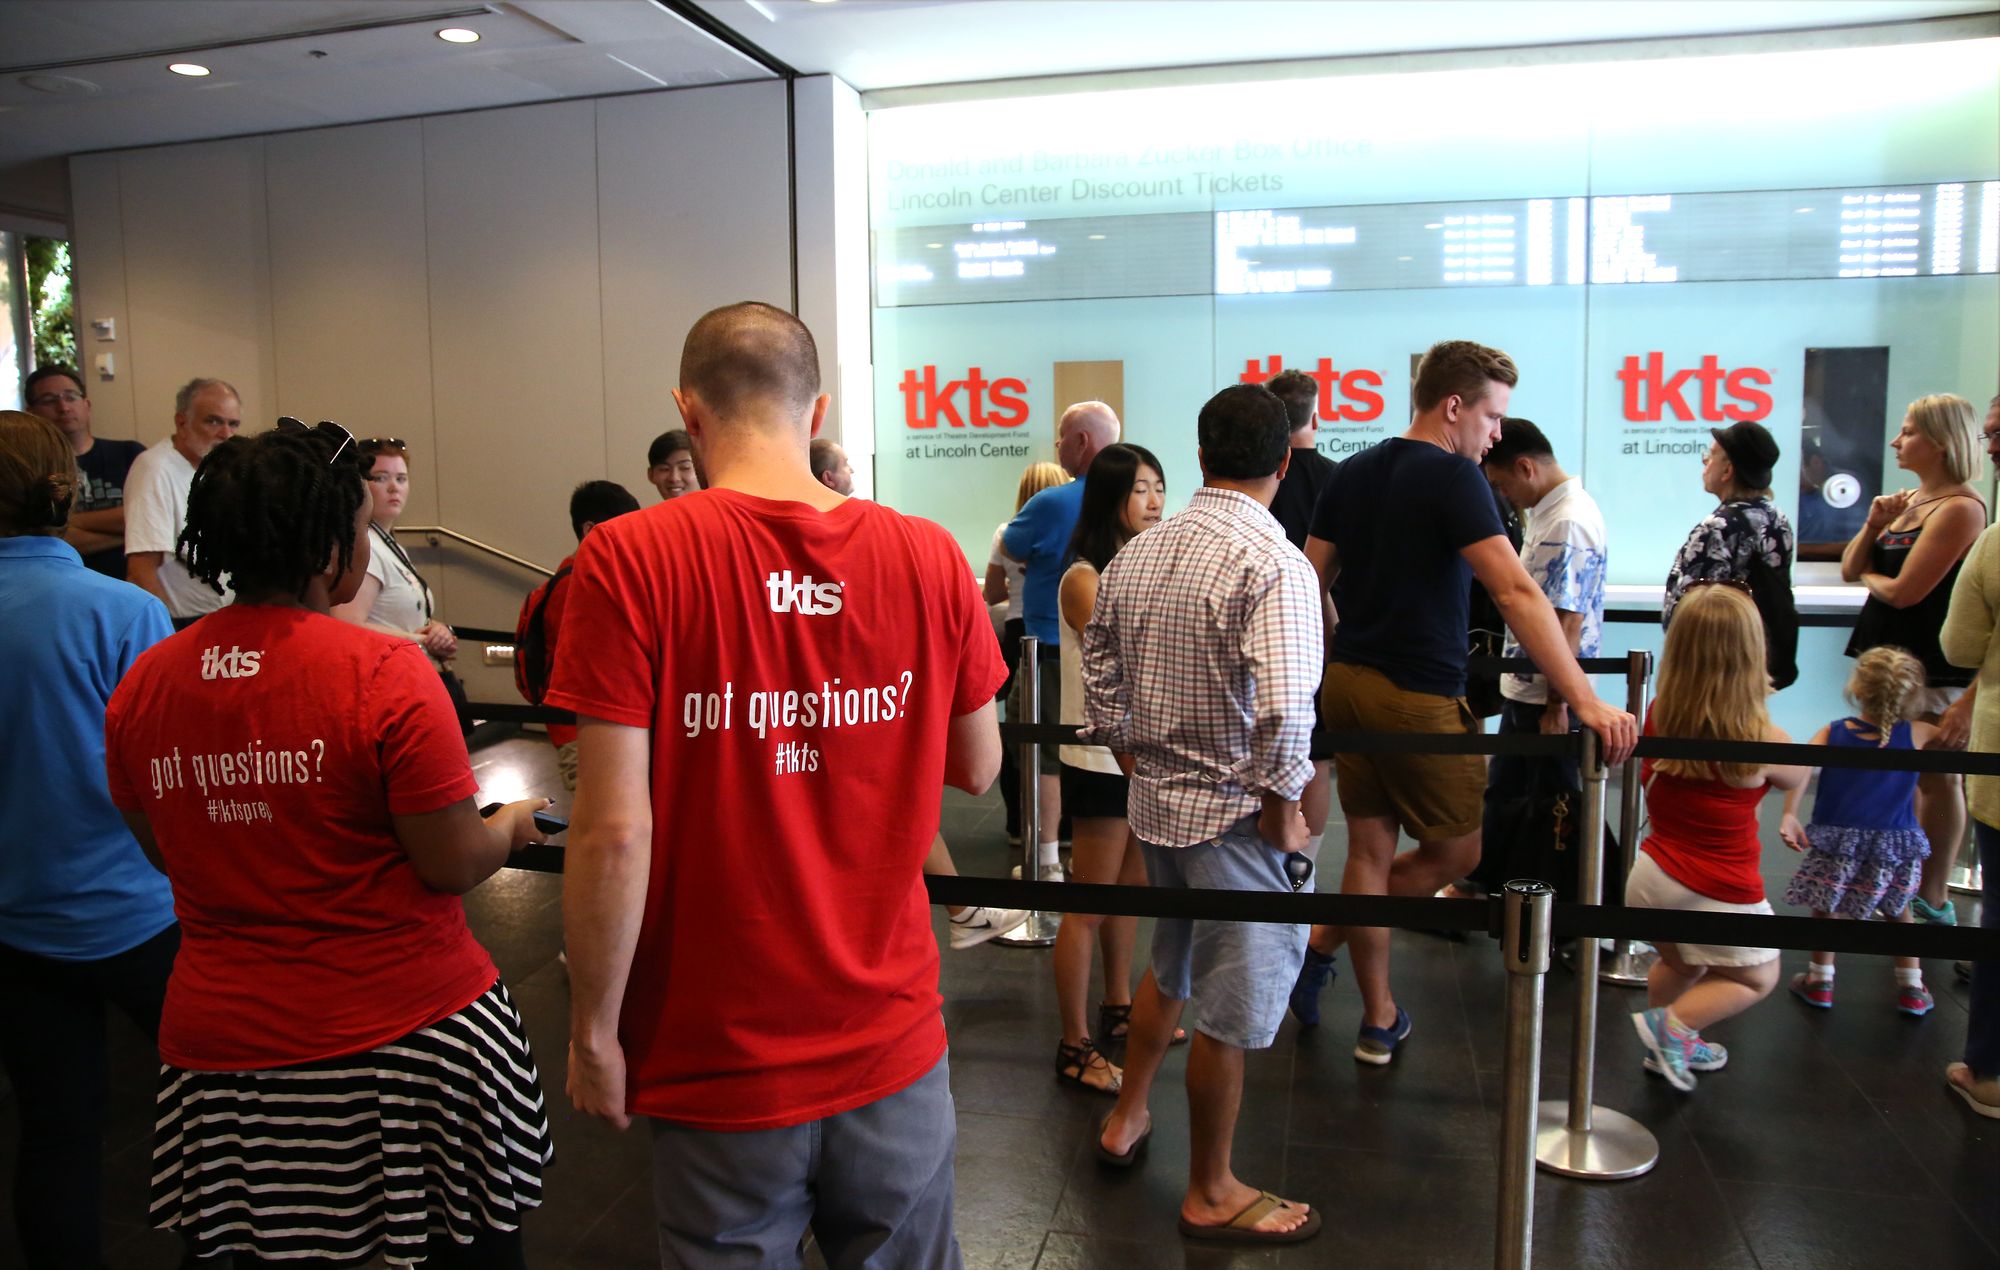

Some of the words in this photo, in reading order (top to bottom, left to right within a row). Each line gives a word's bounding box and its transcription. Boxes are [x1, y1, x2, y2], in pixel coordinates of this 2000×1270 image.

[887, 154, 970, 181] Donald
[978, 152, 1022, 175] and
[1032, 148, 1129, 172] Barbara
[1137, 142, 1224, 166] Zucker
[1235, 138, 1284, 161] Box
[888, 186, 972, 211] Lincoln
[981, 184, 1062, 206] Center
[1071, 174, 1184, 201] Discount
[1192, 170, 1284, 195] Tickets
[898, 365, 1030, 429] tkts
[1617, 351, 1774, 422] tkts
[906, 447, 920, 458] at
[924, 443, 977, 458] Lincoln
[980, 443, 1030, 457] Center
[1330, 438, 1380, 453] Cente
[1623, 441, 1639, 454] at
[1646, 439, 1707, 455] Lincoln
[766, 570, 843, 616] tkts
[201, 645, 261, 680] tkts
[683, 681, 734, 738] got
[748, 670, 913, 739] questions?
[151, 747, 184, 799] got
[192, 738, 325, 796] questions?
[776, 741, 819, 775] #tkts
